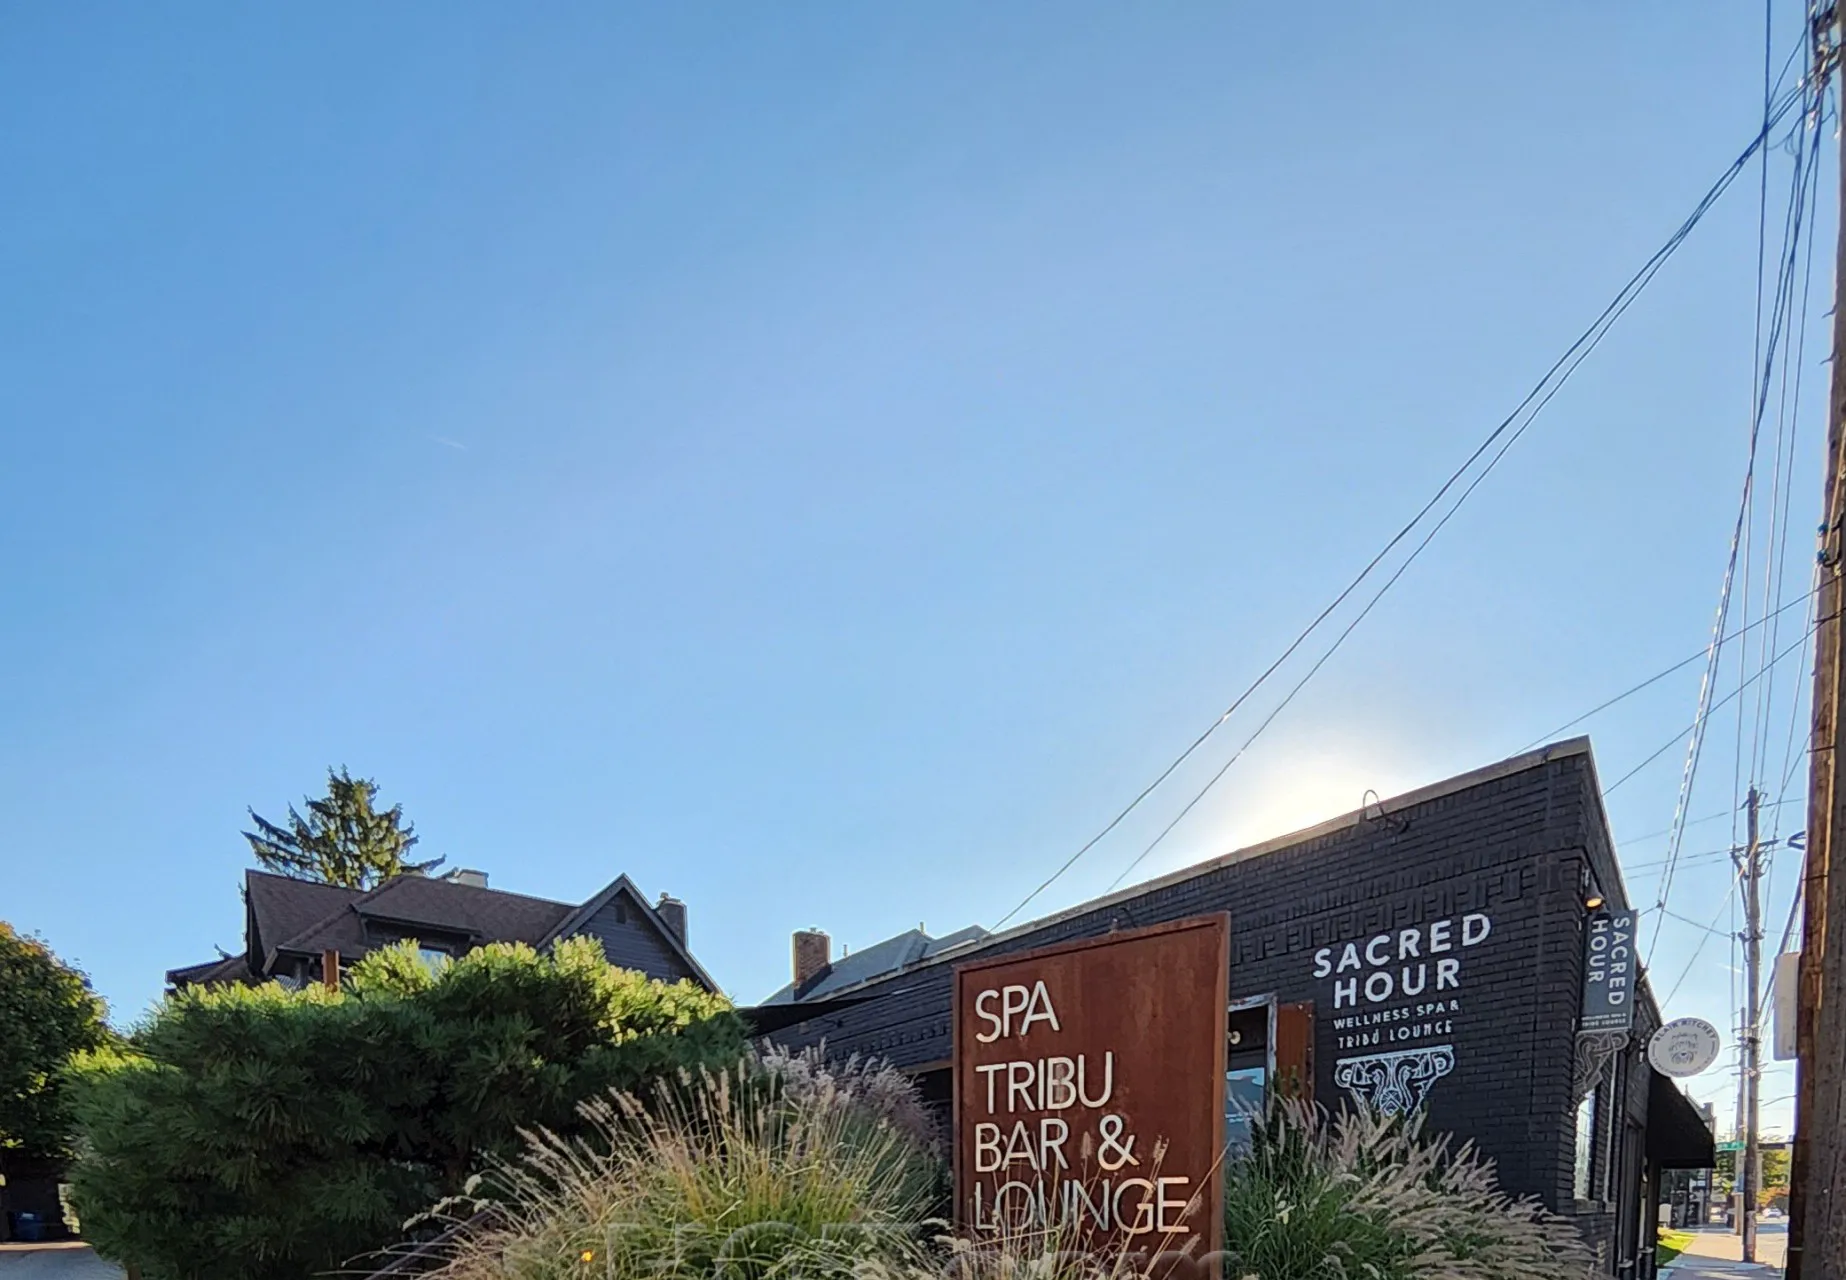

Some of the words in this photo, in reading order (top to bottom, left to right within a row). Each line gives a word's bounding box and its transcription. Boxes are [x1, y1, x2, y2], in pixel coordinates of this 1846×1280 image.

[1313, 913, 1491, 978] SACRED
[1588, 919, 1608, 983] HOUR
[1608, 917, 1631, 1005] SACRED
[975, 980, 1060, 1043] SPA
[1334, 958, 1460, 1009] HOUR
[1333, 1006, 1410, 1030] WELLNESS
[1416, 1002, 1446, 1017] SPA
[1389, 1020, 1453, 1042] LOUNGE
[975, 1051, 1113, 1114] TRIBU
[975, 1118, 1069, 1173] BAR
[1098, 1114, 1140, 1171] &
[975, 1176, 1190, 1234] LOUNGE
